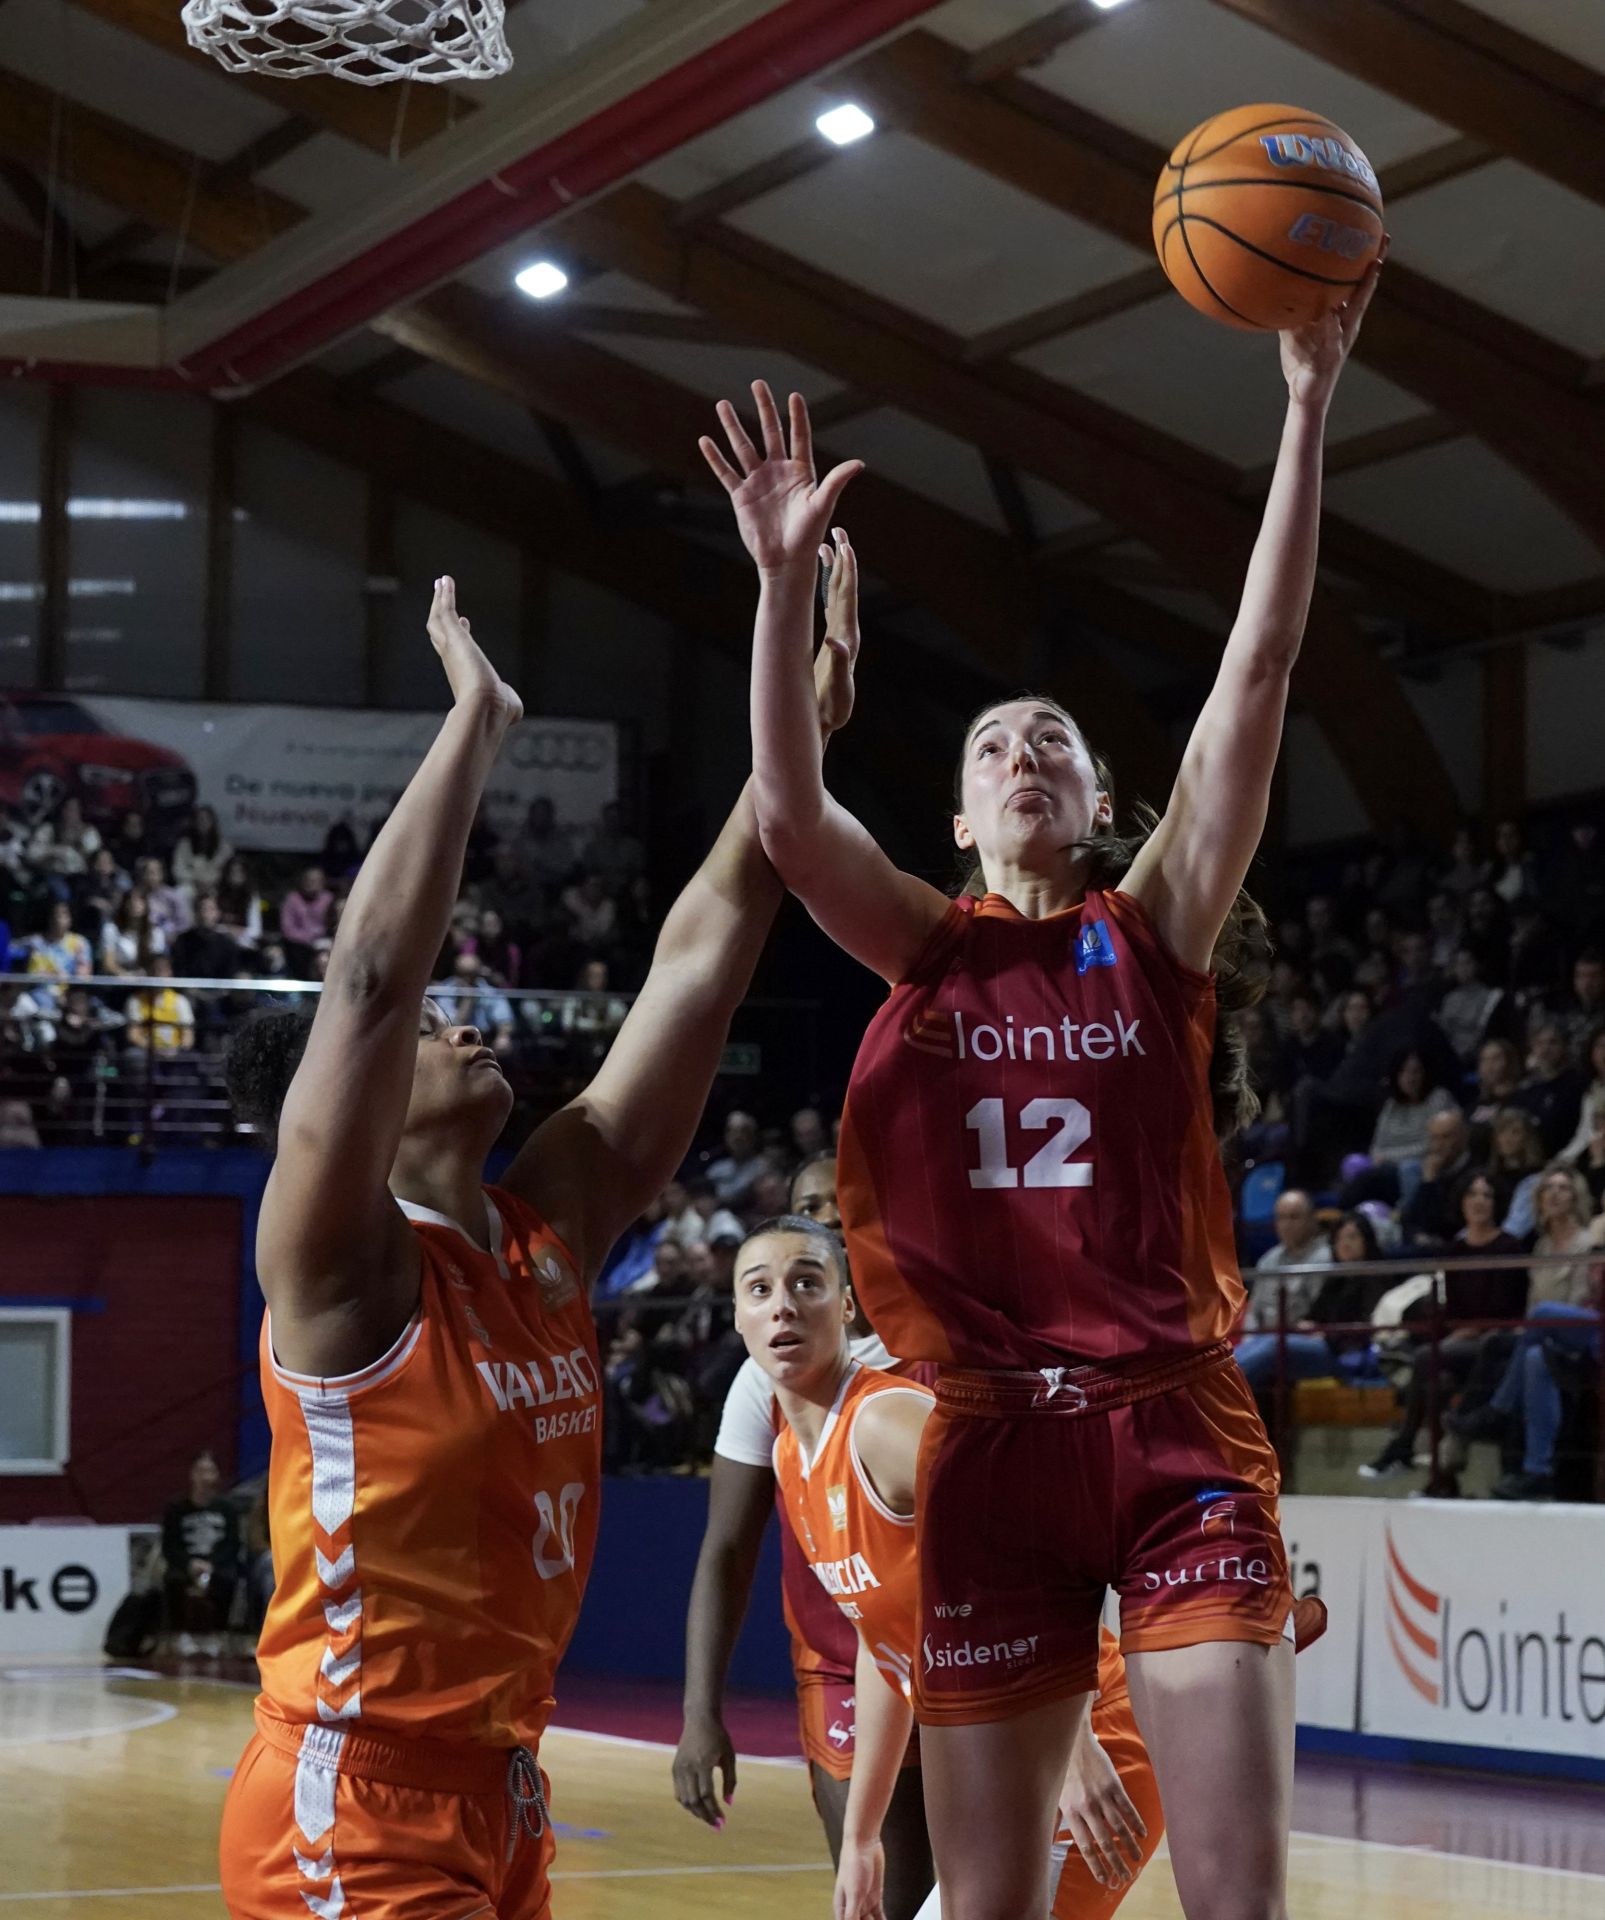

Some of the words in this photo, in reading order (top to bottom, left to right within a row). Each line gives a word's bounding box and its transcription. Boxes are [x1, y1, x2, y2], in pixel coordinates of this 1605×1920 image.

[954, 1009, 1147, 1061] lointek
[965, 1097, 1094, 1189] 12
[535, 1404, 597, 1445] BASKET
[934, 1602, 974, 1619] vive
[935, 1634, 1039, 1668] sidenor
